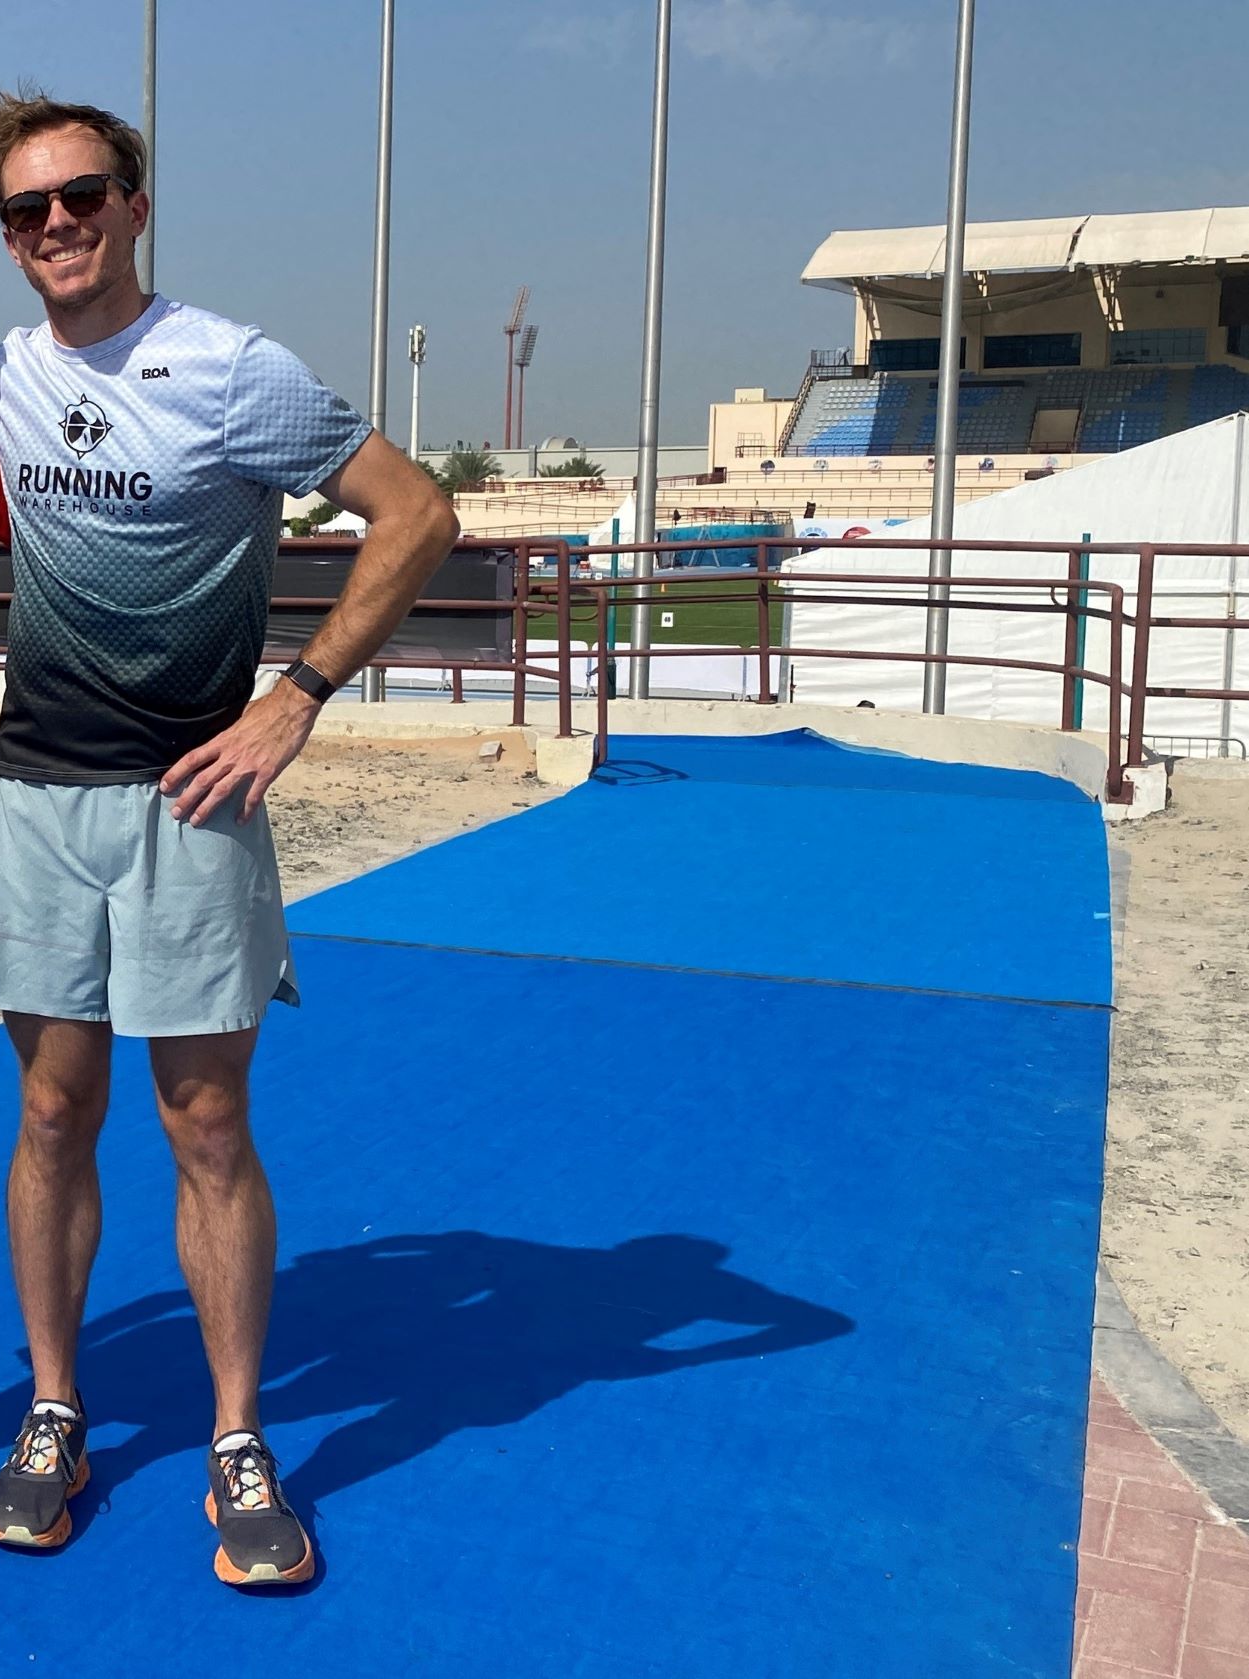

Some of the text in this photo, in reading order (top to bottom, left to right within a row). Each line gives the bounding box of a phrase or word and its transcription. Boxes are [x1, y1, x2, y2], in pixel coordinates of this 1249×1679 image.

[142, 367, 170, 380] BOA
[18, 464, 153, 501] RUNNING
[19, 496, 151, 516] WAREHOUSE
